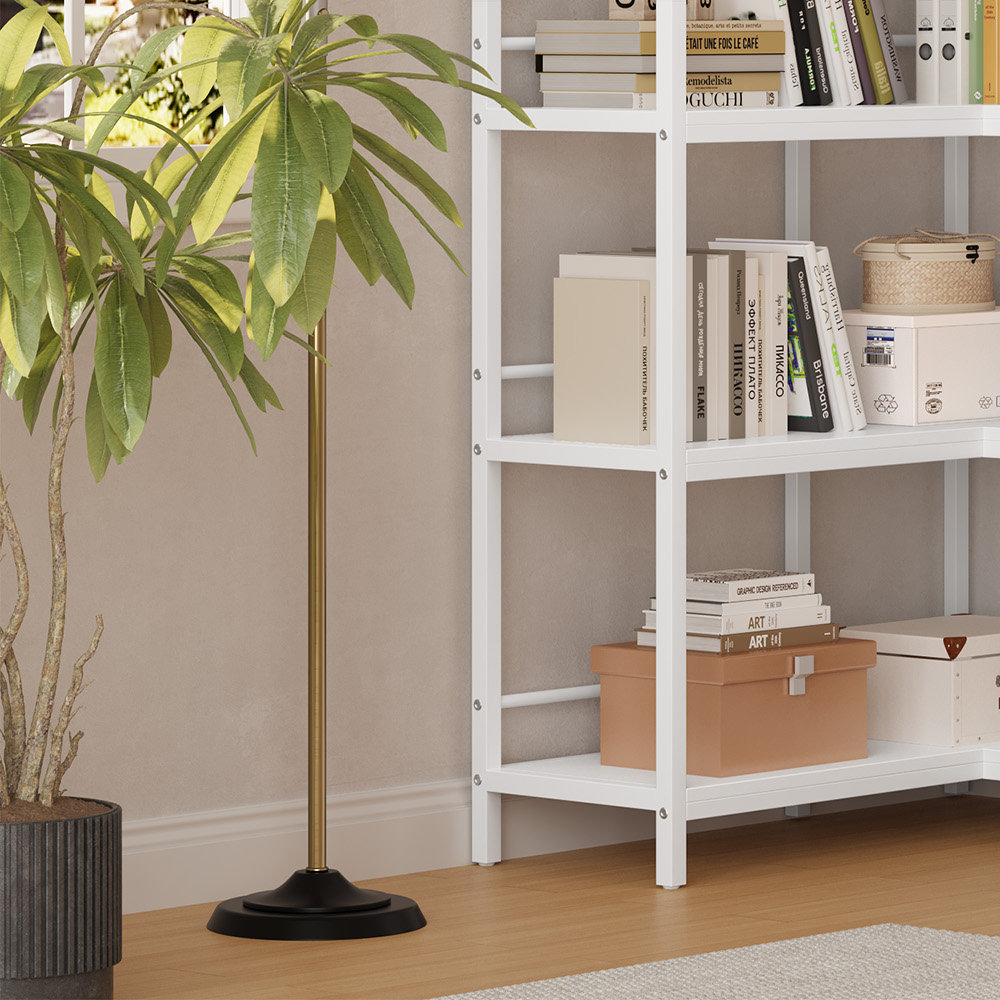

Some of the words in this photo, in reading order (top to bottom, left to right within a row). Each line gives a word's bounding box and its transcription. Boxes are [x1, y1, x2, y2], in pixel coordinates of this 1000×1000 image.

[704, 38, 717, 50] UNE
[718, 37, 732, 49] FOIS
[733, 37, 741, 49] LE
[742, 35, 759, 49] CAFÉ
[748, 299, 756, 351] ЭФФЕКТ
[797, 271, 811, 320] Queensland
[813, 359, 830, 419] Brisbane
[733, 343, 743, 416] ПИКАССО
[748, 356, 756, 400] ПЛАТО
[775, 345, 785, 398] ПИКАССО
[697, 386, 705, 419] FLAKE
[737, 586, 755, 596] GRAPHIC
[756, 585, 771, 594] DESIGN
[772, 582, 799, 592] REFERENCED
[748, 615, 765, 630] ART
[748, 634, 768, 649] ART
